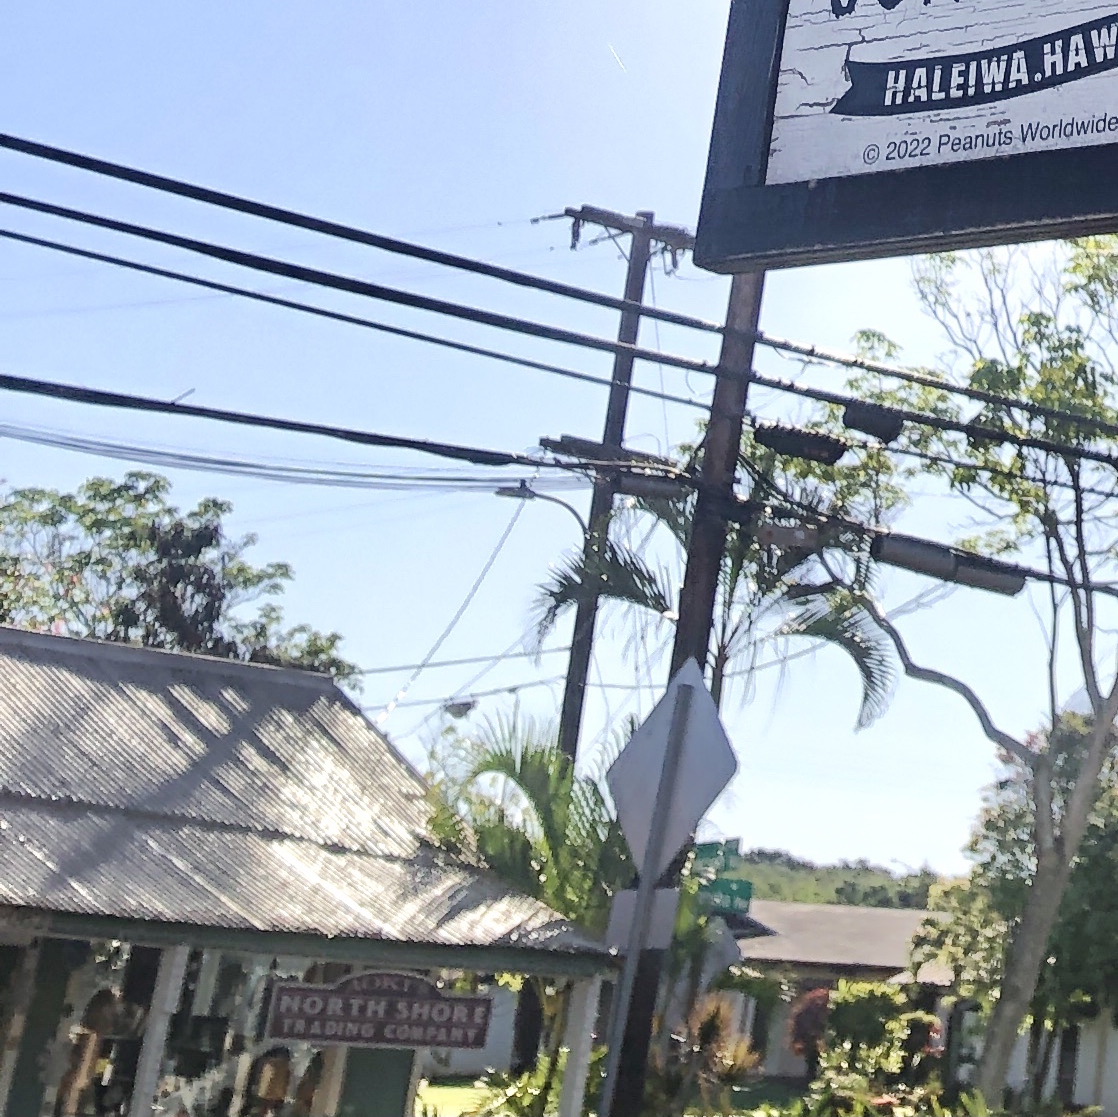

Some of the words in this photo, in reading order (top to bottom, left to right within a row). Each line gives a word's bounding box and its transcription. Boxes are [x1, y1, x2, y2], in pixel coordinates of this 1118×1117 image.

[885, 139, 930, 162] 2022
[937, 128, 1013, 154] Peanuts
[1020, 113, 1118, 144] Worldwide
[279, 995, 386, 1019] NORTH
[396, 998, 488, 1025] SHORE
